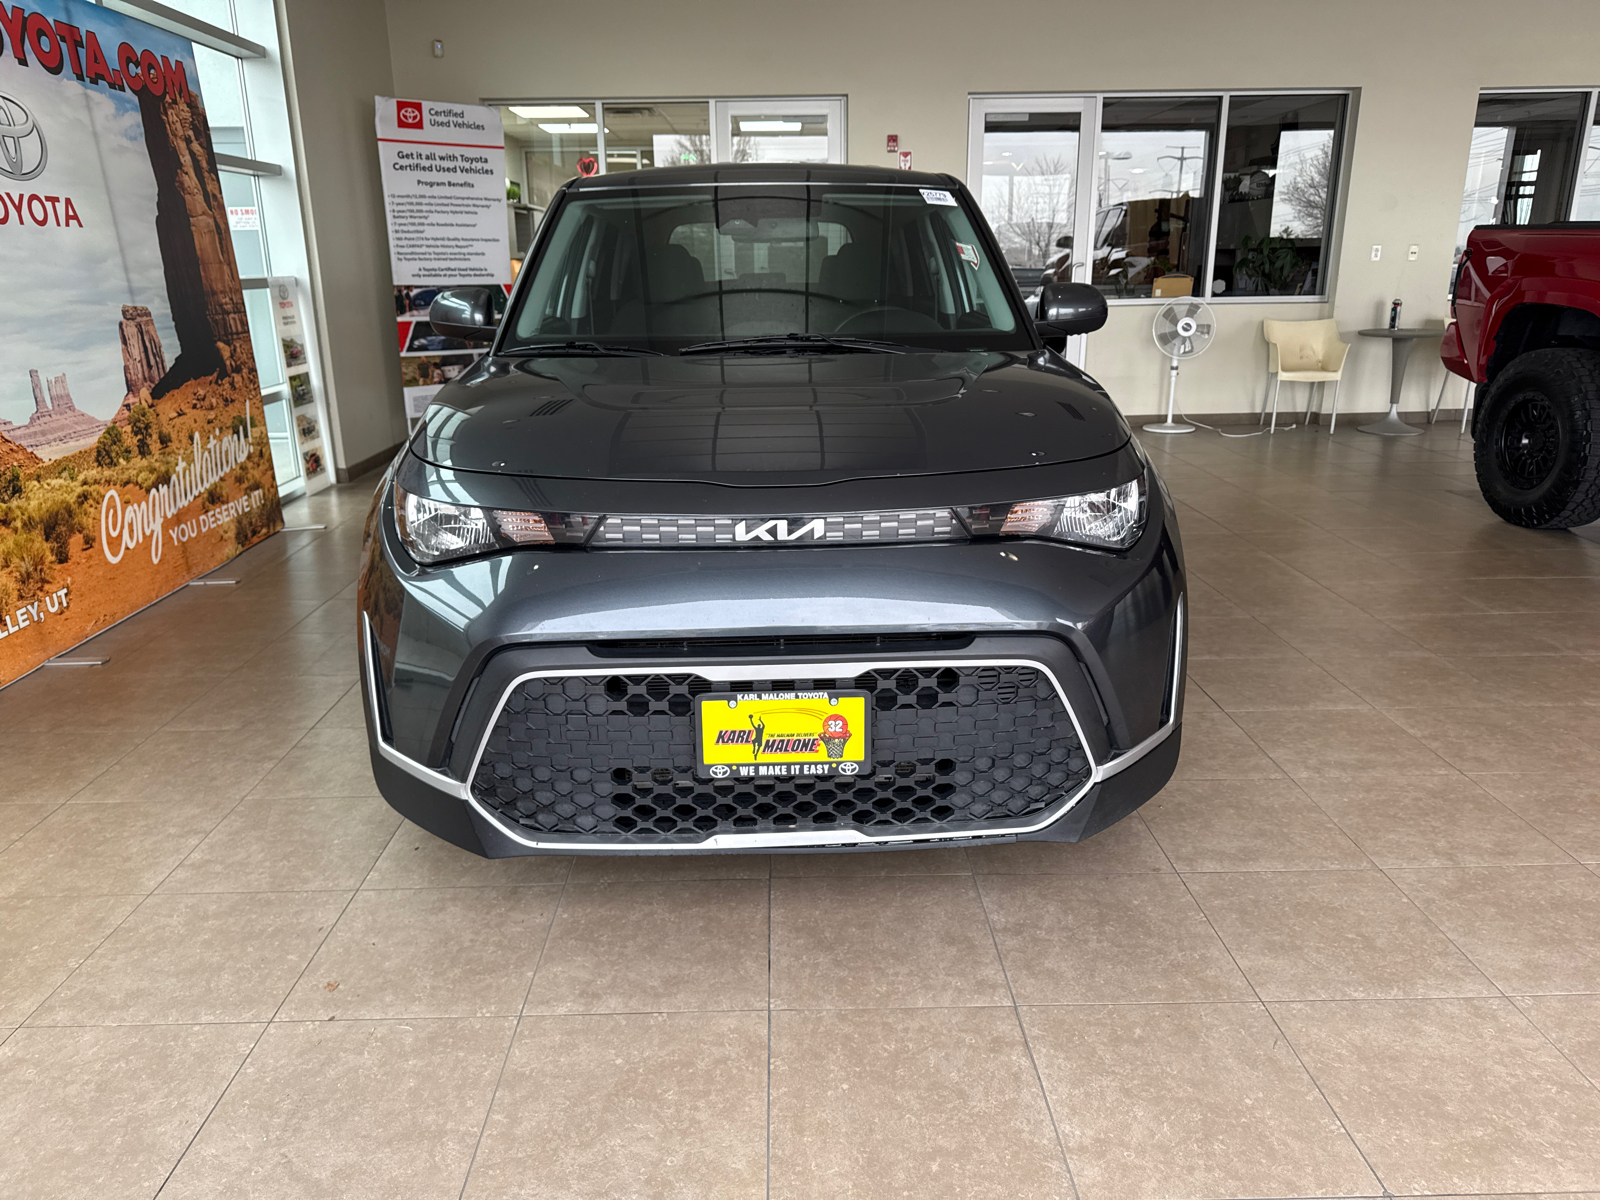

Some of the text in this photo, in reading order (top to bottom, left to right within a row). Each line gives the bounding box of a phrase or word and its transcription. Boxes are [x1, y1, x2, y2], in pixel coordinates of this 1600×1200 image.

[0, 0, 190, 103] YOTA.COM
[428, 107, 465, 119] Certified
[429, 119, 486, 131] Used Vehicles
[396, 151, 489, 165] Get it all with Toyota
[392, 162, 494, 176] Certified Used Vehicles
[416, 180, 475, 189] Program Benefits
[101, 398, 254, 564] Congratulations!
[169, 488, 264, 546] YOU DESERVE IT!
[735, 519, 824, 541] KIA
[45, 588, 68, 613] UT
[762, 692, 796, 700] MALONE
[798, 692, 829, 700] TOYOTA
[828, 720, 843, 732] 32
[715, 730, 754, 745] KARL
[761, 738, 820, 754] MALONE
[740, 764, 829, 776] WE MAKE IT EASY
